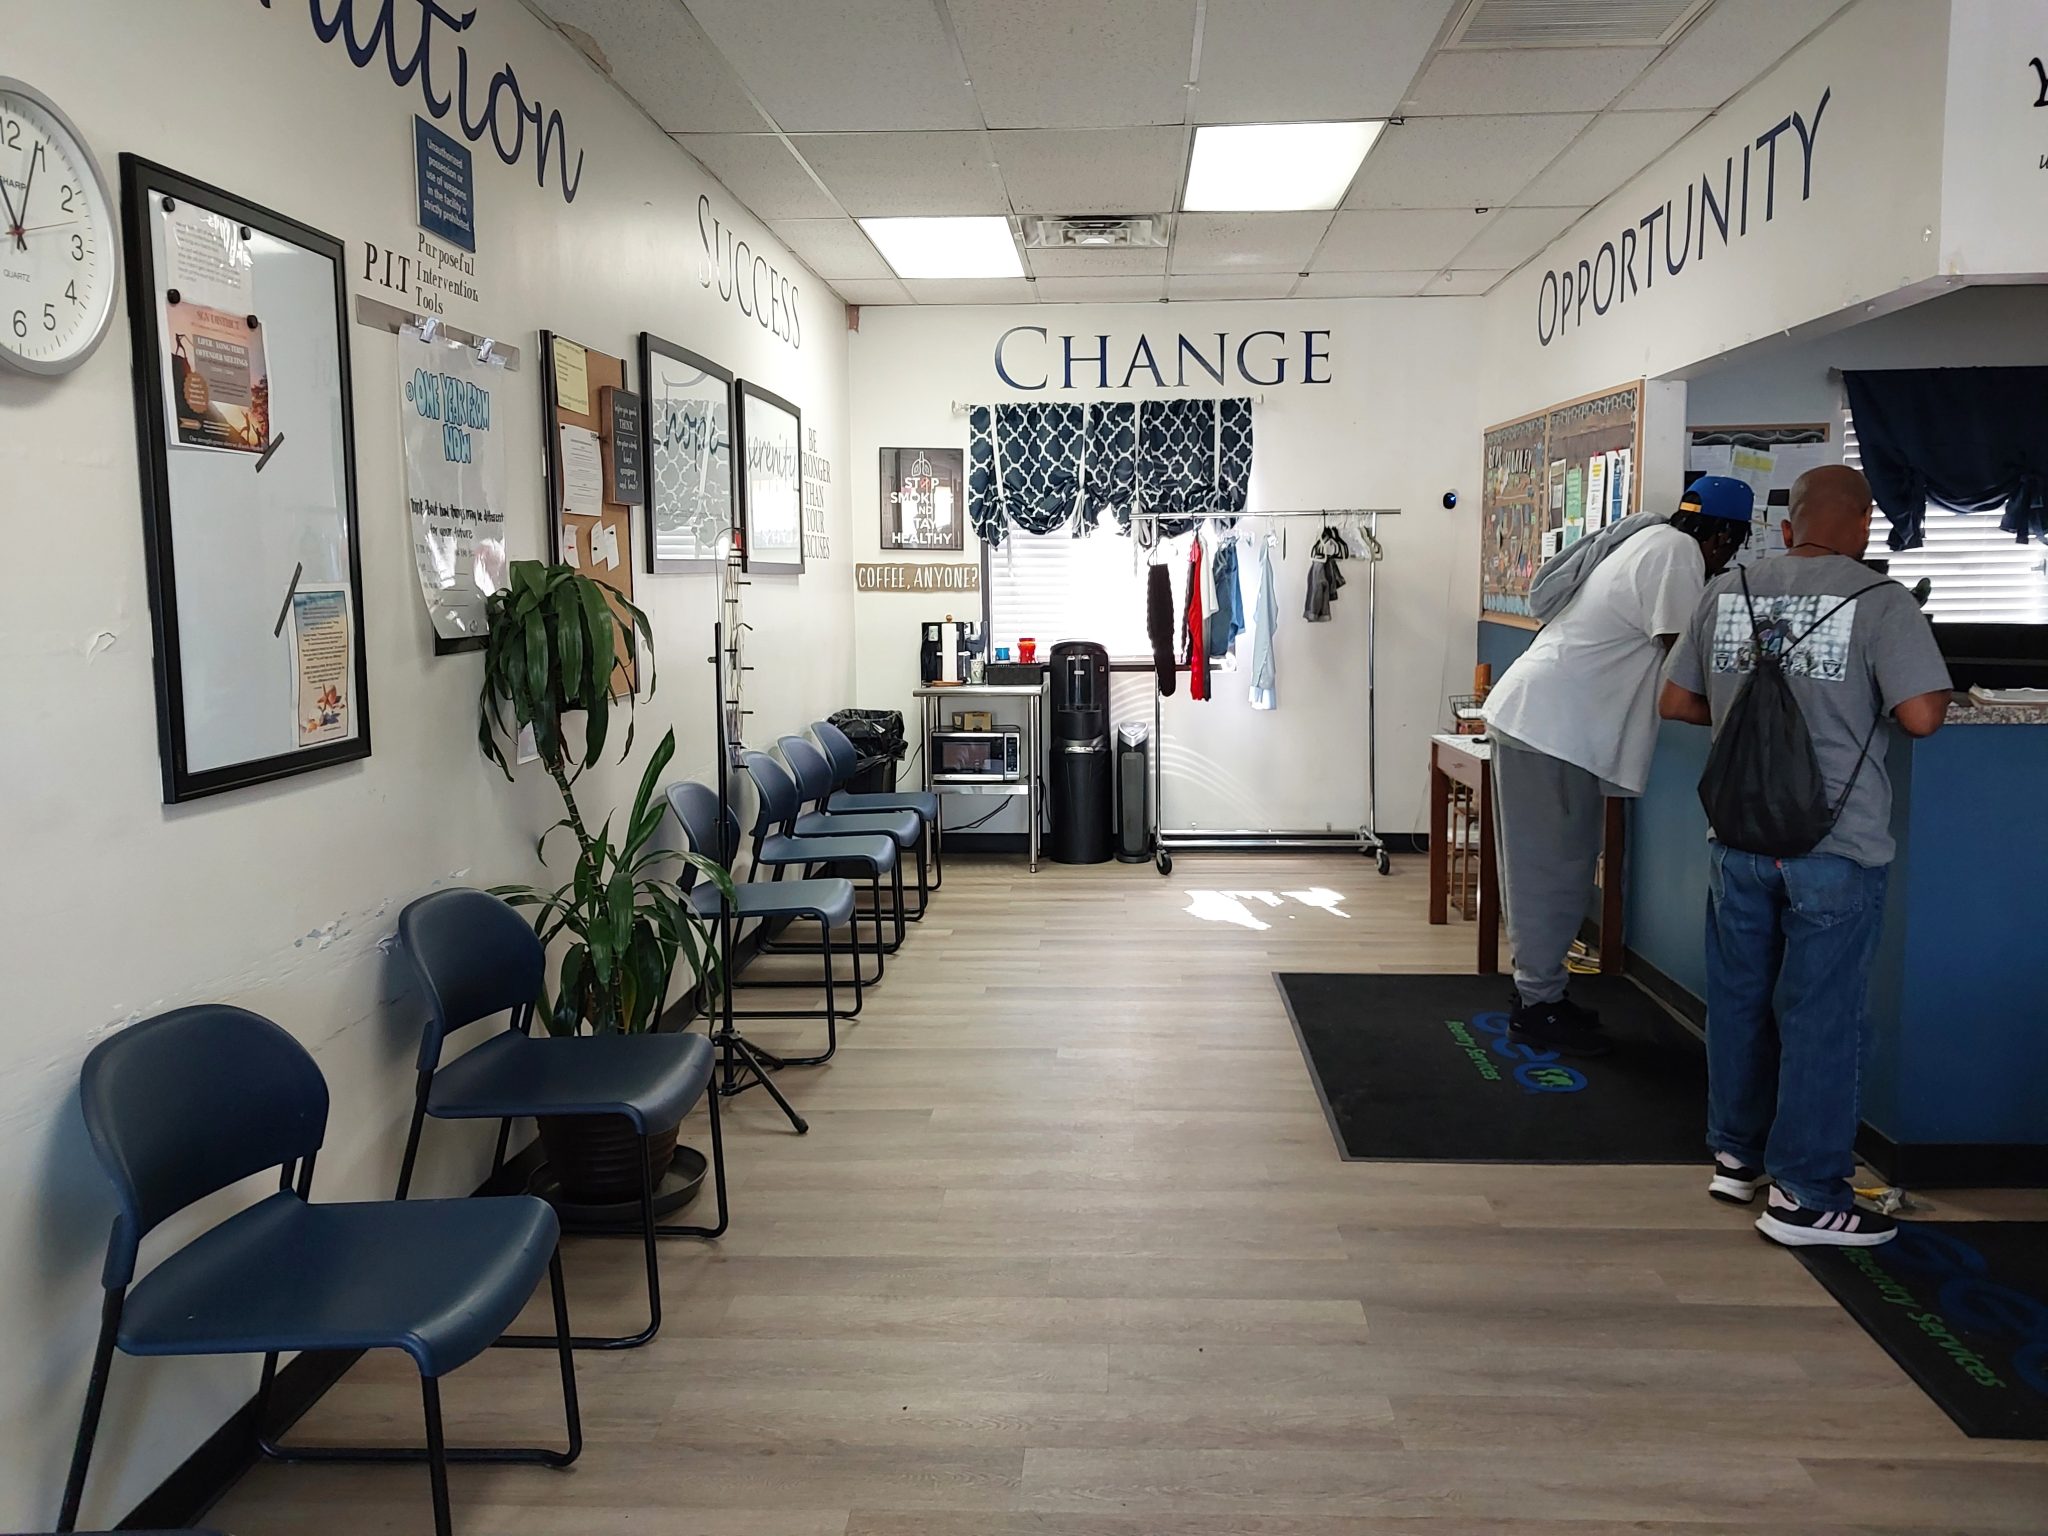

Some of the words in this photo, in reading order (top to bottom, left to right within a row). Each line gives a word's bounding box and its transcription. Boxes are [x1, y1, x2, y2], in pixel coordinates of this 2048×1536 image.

[427, 138, 463, 169] Unauthorized
[0, 176, 26, 190] HARP
[428, 156, 456, 180] possession
[457, 174, 464, 184] or
[60, 185, 73, 213] 2
[426, 170, 436, 182] use
[436, 176, 443, 186] of
[443, 182, 467, 200] weapons
[427, 183, 434, 196] in
[434, 187, 443, 202] the
[444, 193, 462, 214] facility
[423, 199, 442, 218] strictly
[1538, 85, 1831, 347] OPPORTUNITY
[71, 234, 84, 261] 3
[418, 232, 475, 276] Purposeful
[3, 269, 31, 283] QUARTZ
[416, 260, 479, 302] Intervention
[698, 194, 800, 349] SUCCESS
[64, 279, 77, 305] 4
[416, 286, 444, 315] Tools
[13, 310, 27, 337] 6
[43, 303, 56, 330] 5
[994, 325, 1333, 391] CHANGE
[414, 368, 440, 420] ONE
[439, 373, 466, 426] YEAR
[465, 381, 490, 431] FROM
[443, 424, 472, 464] NOW
[808, 427, 817, 454] BE
[803, 452, 831, 483] RONGER
[804, 481, 824, 508] THAN
[890, 492, 954, 504] SMOKIG
[805, 507, 824, 533] YOUR
[905, 518, 937, 530] TAY
[440, 527, 452, 543] your
[454, 526, 473, 540] future
[892, 532, 952, 545] HEALTHY
[858, 567, 911, 590] COFFEE,
[913, 566, 978, 589] ANYONE?
[1465, 1048, 1502, 1080] Services
[1907, 1312, 2006, 1388] Services
